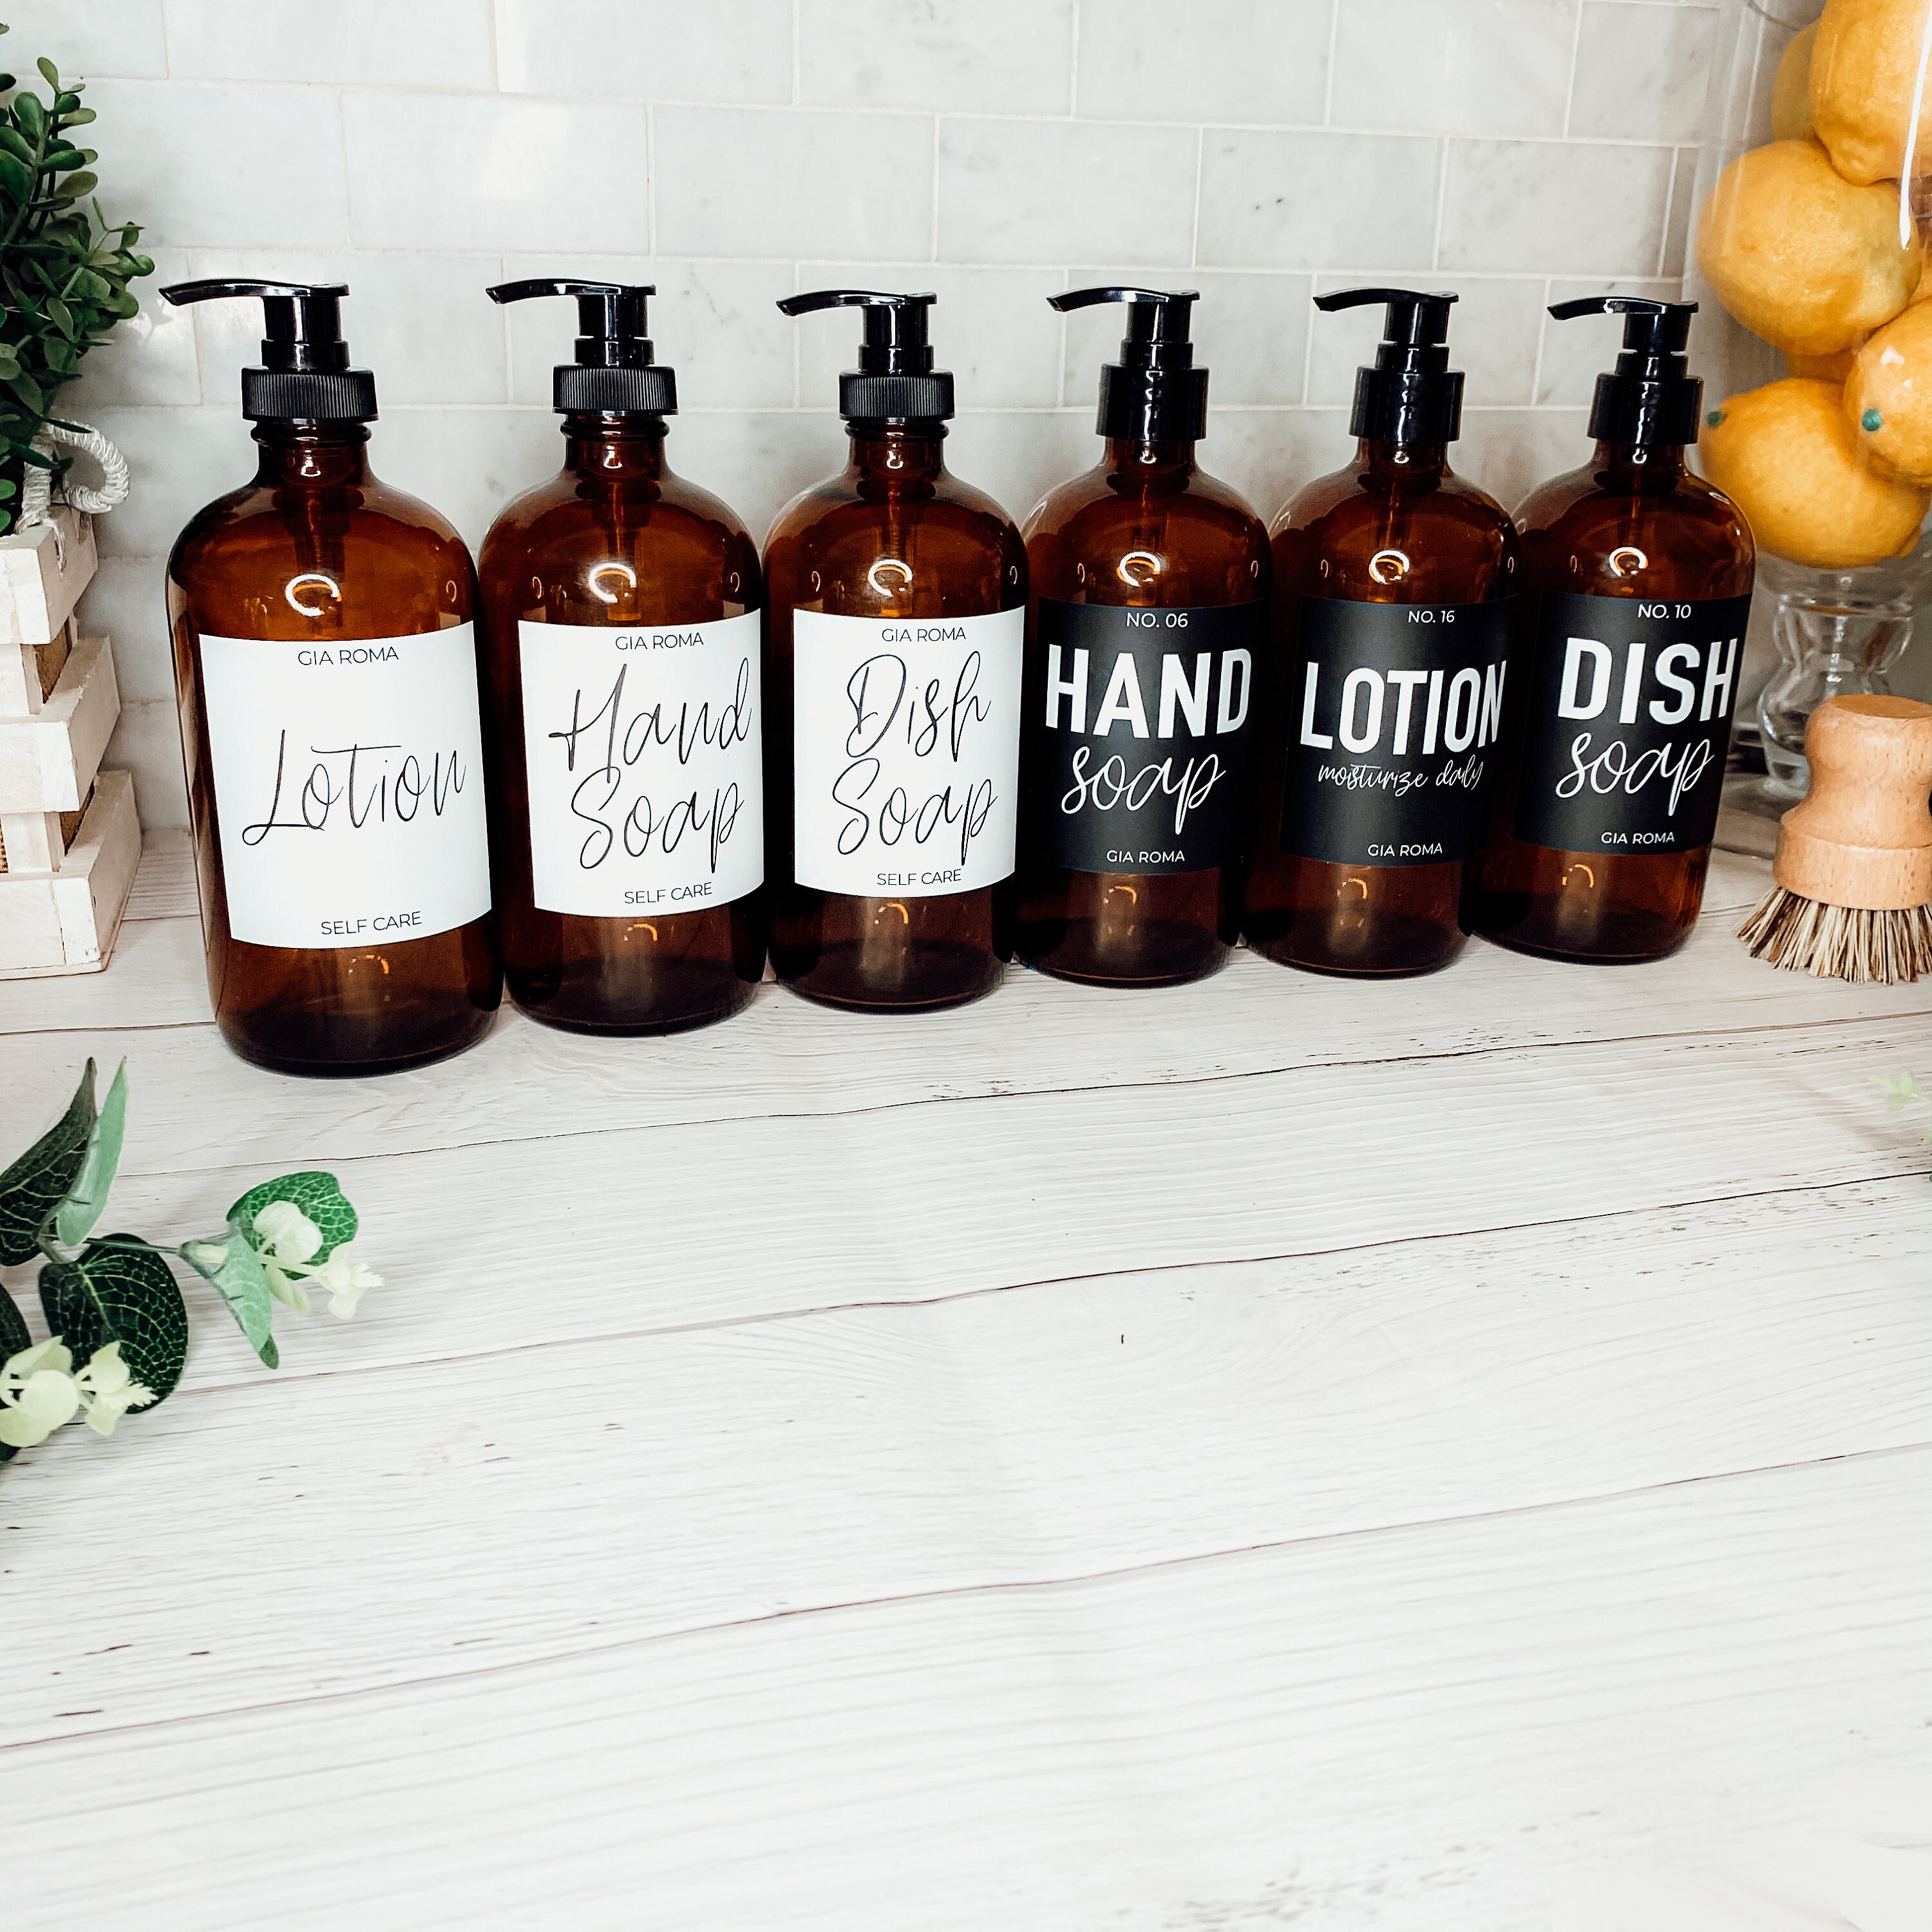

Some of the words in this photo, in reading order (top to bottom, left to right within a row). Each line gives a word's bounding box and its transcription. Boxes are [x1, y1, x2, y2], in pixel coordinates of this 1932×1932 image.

[1126, 612, 1160, 628] NO.
[1165, 612, 1188, 628] 06
[1408, 611, 1436, 623] NO.
[1441, 610, 1455, 623] 16
[1638, 603, 1669, 619] NO.
[1674, 604, 1691, 619] 10
[615, 636, 648, 650] GIA
[653, 632, 704, 650] ROMA
[882, 629, 912, 642] GIA
[917, 627, 967, 642] ROMA
[298, 650, 334, 666] GIA
[339, 646, 399, 665] ROMA
[1045, 643, 1251, 739] HAND
[1557, 637, 1738, 725] DISH
[846, 650, 992, 762] Dish
[1300, 660, 1507, 755] LOTION
[548, 657, 752, 784] Hand
[1318, 763, 1428, 797] moisturize
[1435, 754, 1484, 790] daily
[1555, 732, 1715, 817] soap
[242, 729, 467, 846] Lotion
[1061, 746, 1227, 835] soap
[570, 766, 745, 874] Soap
[832, 757, 999, 866] Soap
[1367, 844, 1396, 857] GIA
[1399, 842, 1443, 857] ROMA
[1601, 831, 1628, 844] GIA
[1632, 831, 1674, 844] ROMA
[1106, 849, 1134, 864] GIA
[1139, 850, 1185, 864] ROMA
[877, 873, 917, 886] SELF
[921, 868, 961, 885] CARE
[624, 889, 666, 904] SELF
[670, 881, 713, 900] CARE
[321, 918, 367, 935] SELF
[373, 911, 422, 931] CARE
